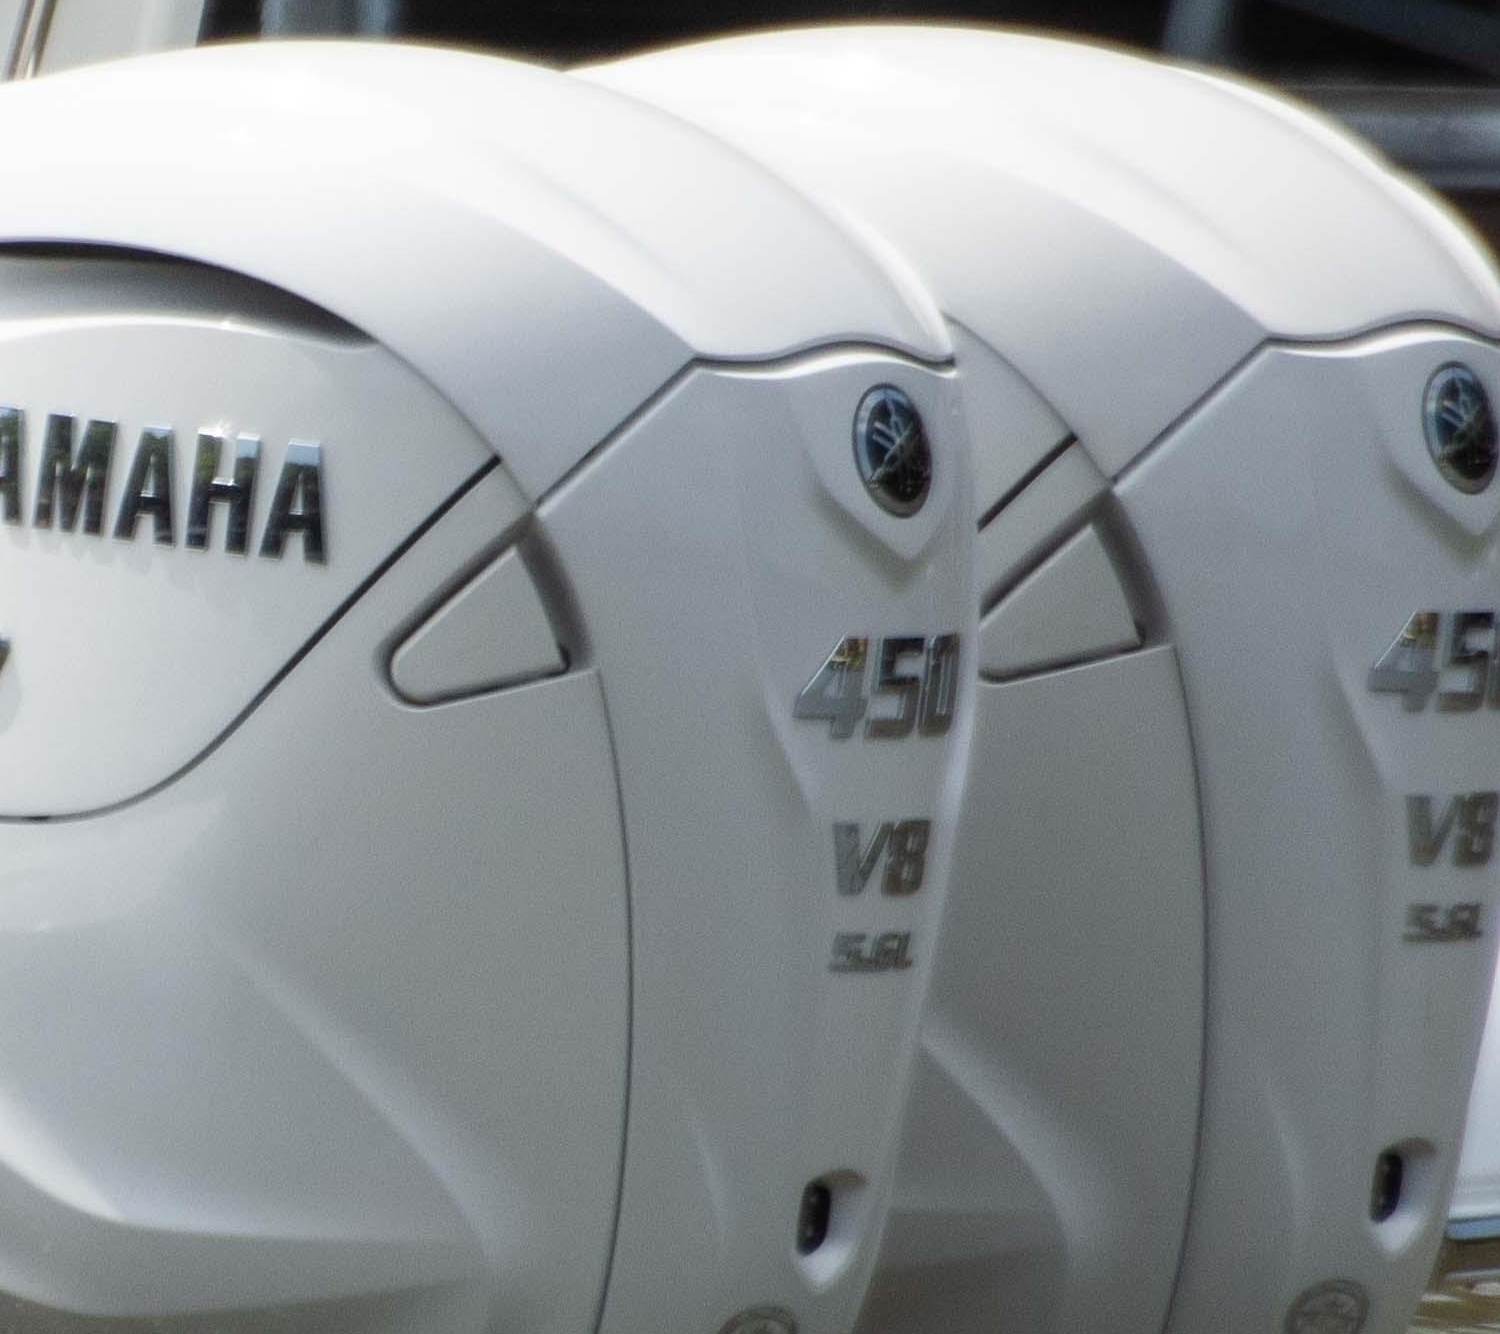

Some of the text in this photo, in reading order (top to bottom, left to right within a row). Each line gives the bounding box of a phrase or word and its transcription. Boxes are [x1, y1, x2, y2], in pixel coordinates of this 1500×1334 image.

[793, 633, 961, 740] 450
[832, 819, 932, 896] V8
[1405, 791, 1500, 867] V8
